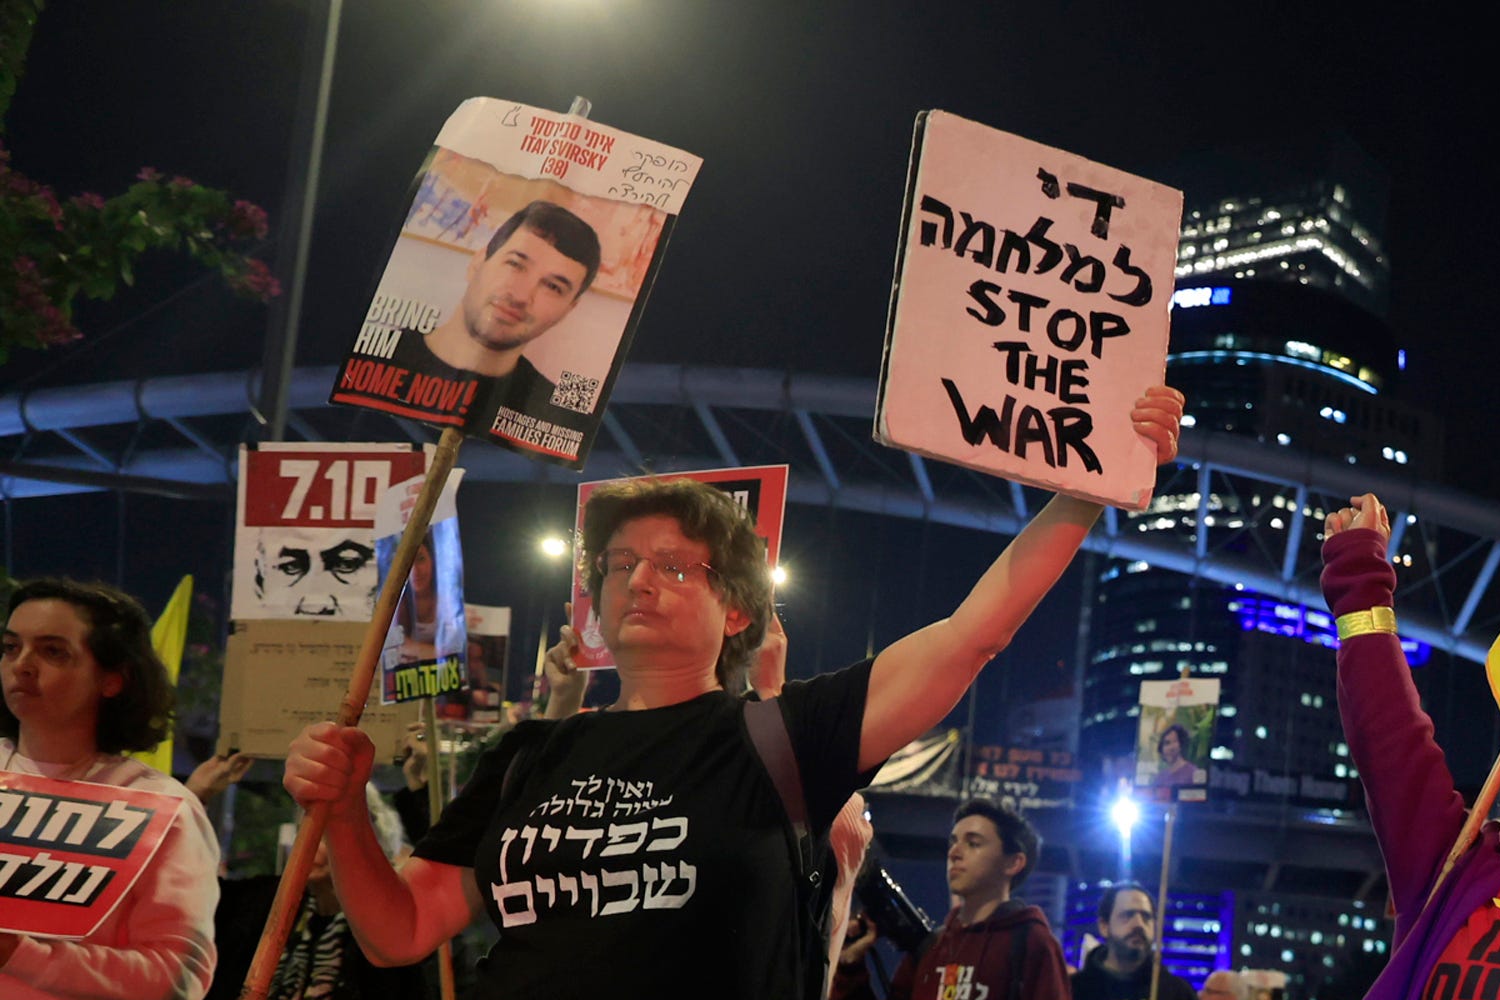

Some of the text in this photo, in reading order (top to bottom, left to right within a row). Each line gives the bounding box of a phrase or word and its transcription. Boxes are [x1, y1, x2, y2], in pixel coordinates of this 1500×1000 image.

[520, 134, 608, 172] ITAY SVIRSKY
[531, 116, 616, 154] איתי סבירסקי
[540, 157, 570, 180] (38)
[1036, 167, 1127, 240] די
[920, 194, 1153, 308] למלחמה
[366, 295, 441, 335] BRING
[966, 279, 1131, 359] STOP
[353, 322, 403, 359] HIM
[340, 358, 479, 415] HOME NOW!
[992, 341, 1091, 405] THE
[491, 415, 582, 457] FAMILIES FORUM
[498, 406, 585, 444] HOSTAGES AND MISSING
[941, 377, 1103, 475] WAR
[279, 459, 392, 521] 7.10
[529, 794, 605, 819] גדולה
[571, 774, 653, 803] ואין לך
[500, 816, 689, 884] כפדיון
[491, 860, 697, 928] שבויים
